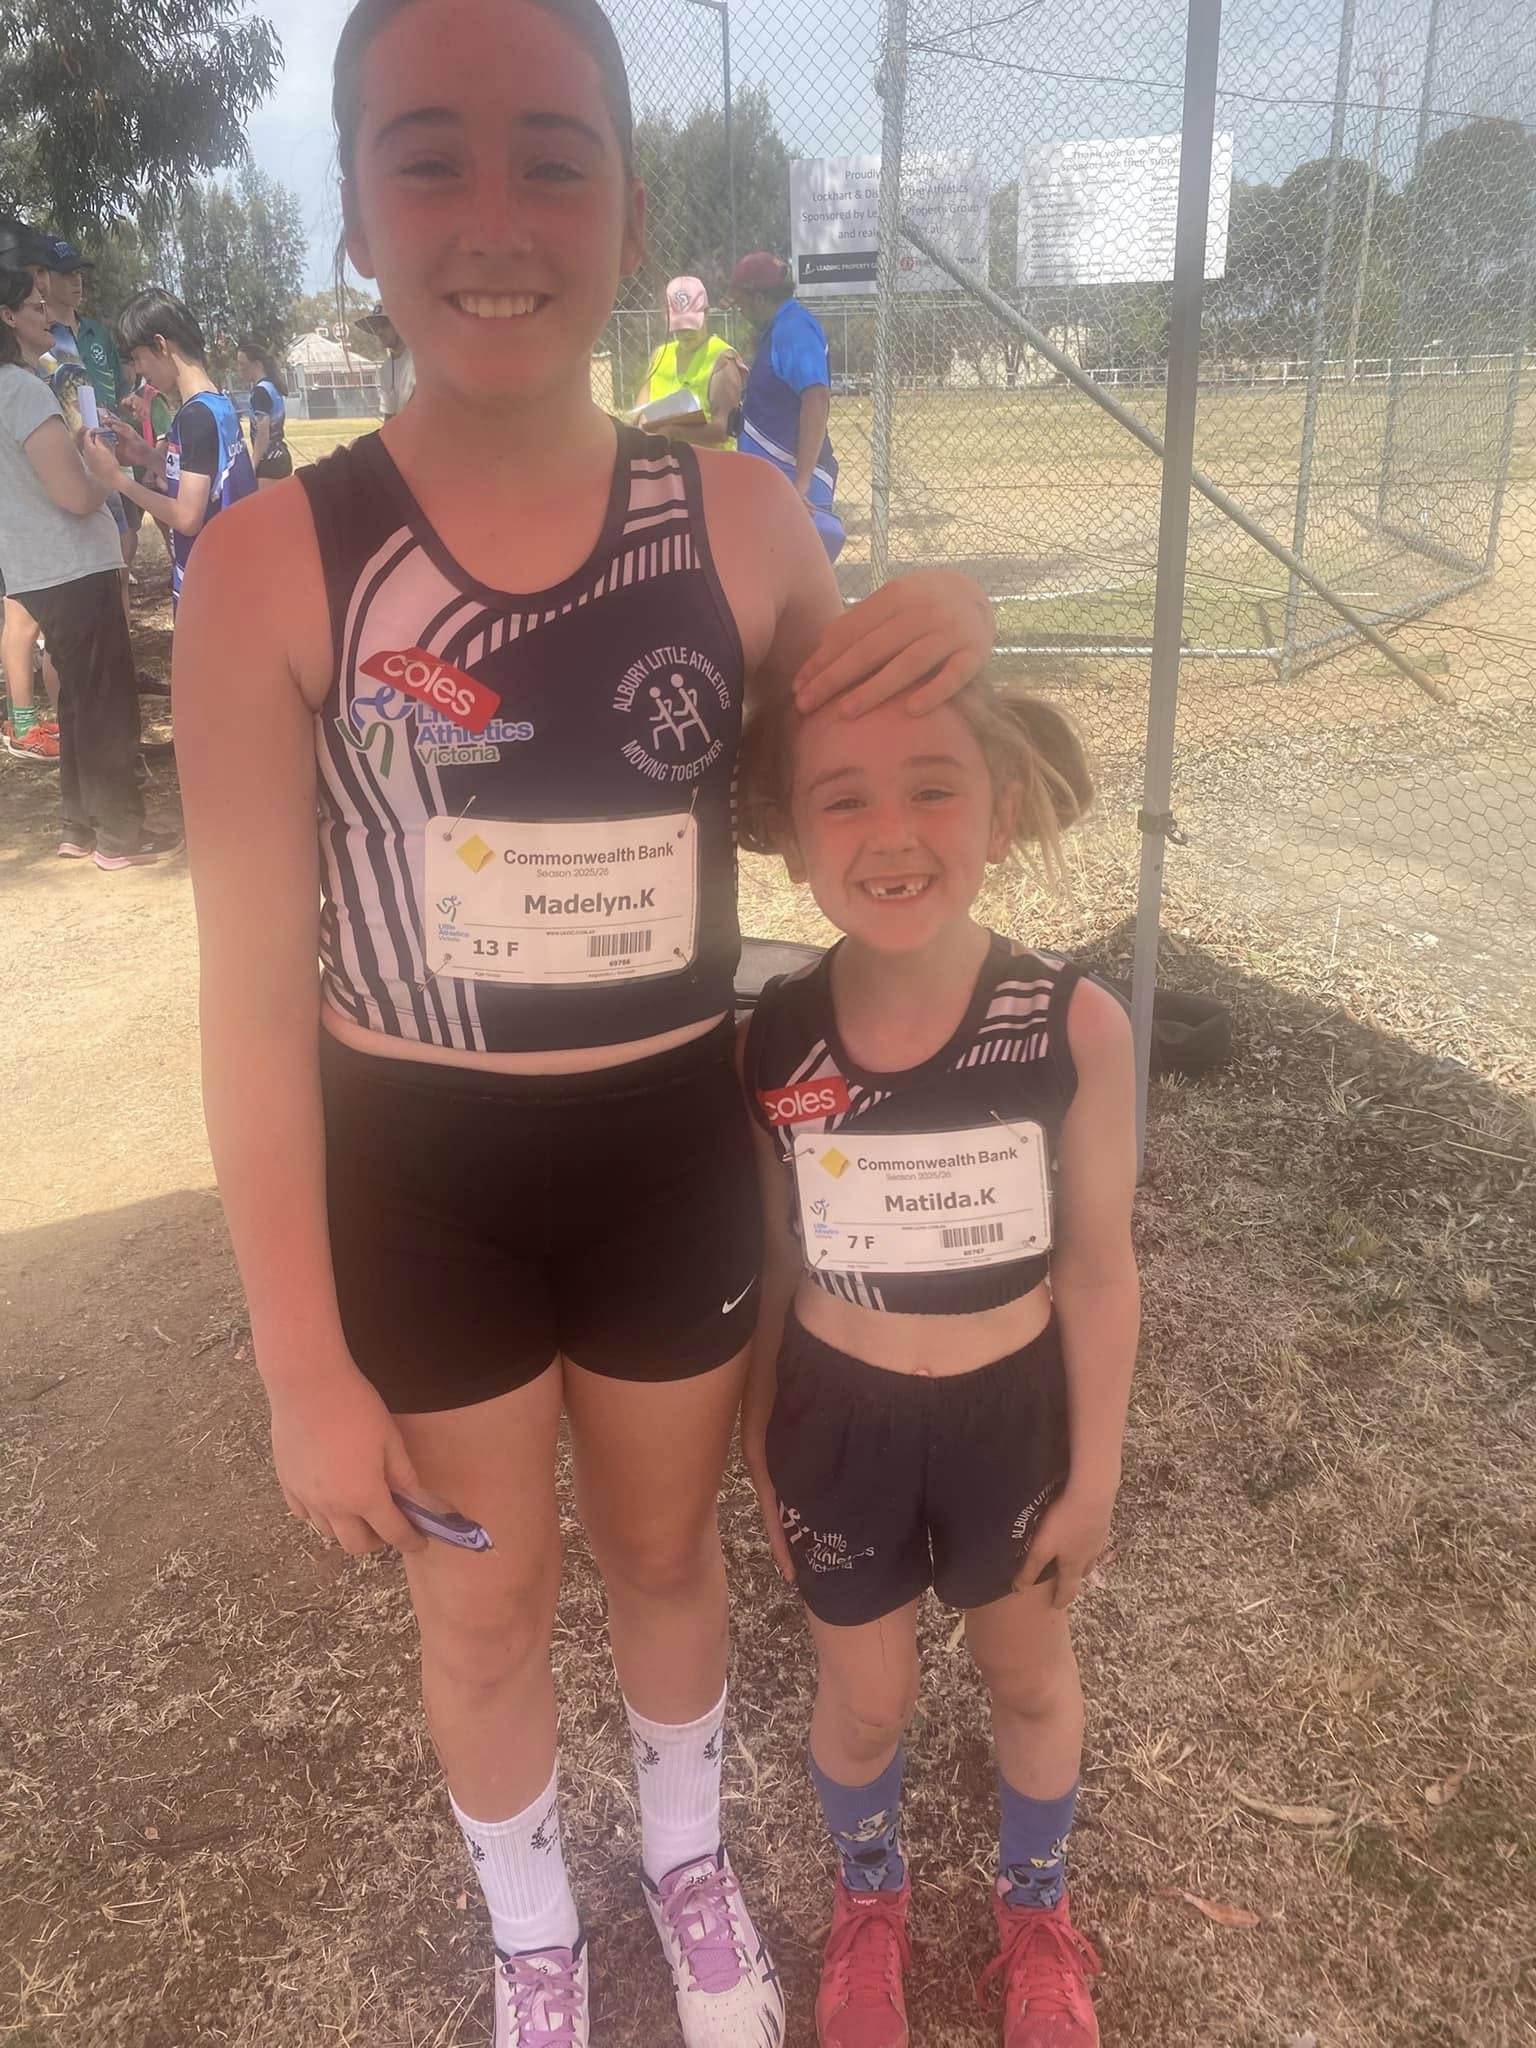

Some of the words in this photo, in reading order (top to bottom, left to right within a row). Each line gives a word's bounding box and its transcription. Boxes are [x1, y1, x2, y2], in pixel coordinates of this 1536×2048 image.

[812, 191, 851, 202] Lockhart
[855, 191, 862, 200] &
[802, 210, 850, 223] Sponsored
[853, 209, 864, 221] by
[838, 230, 856, 240] and
[383, 654, 476, 716] coles
[612, 659, 649, 713] ALBURY
[645, 646, 688, 670] LITTLE
[688, 650, 732, 710] ATHLETICS
[418, 745, 498, 765] Victoria
[621, 739, 669, 781] MOVING
[670, 739, 724, 782] TOGETHER
[503, 846, 635, 866] Commonwealth
[638, 842, 674, 861] Bank
[536, 868, 571, 878] Season
[524, 887, 656, 917] Madelyn.K
[472, 939, 499, 956] 13
[507, 942, 519, 957] F
[857, 1152, 976, 1171] Commonwealth
[978, 1147, 1018, 1164] Bank
[884, 1186, 996, 1213] Matilda.K
[848, 1235, 858, 1249] 7
[864, 1236, 875, 1249] F
[813, 1531, 847, 1552] Little
